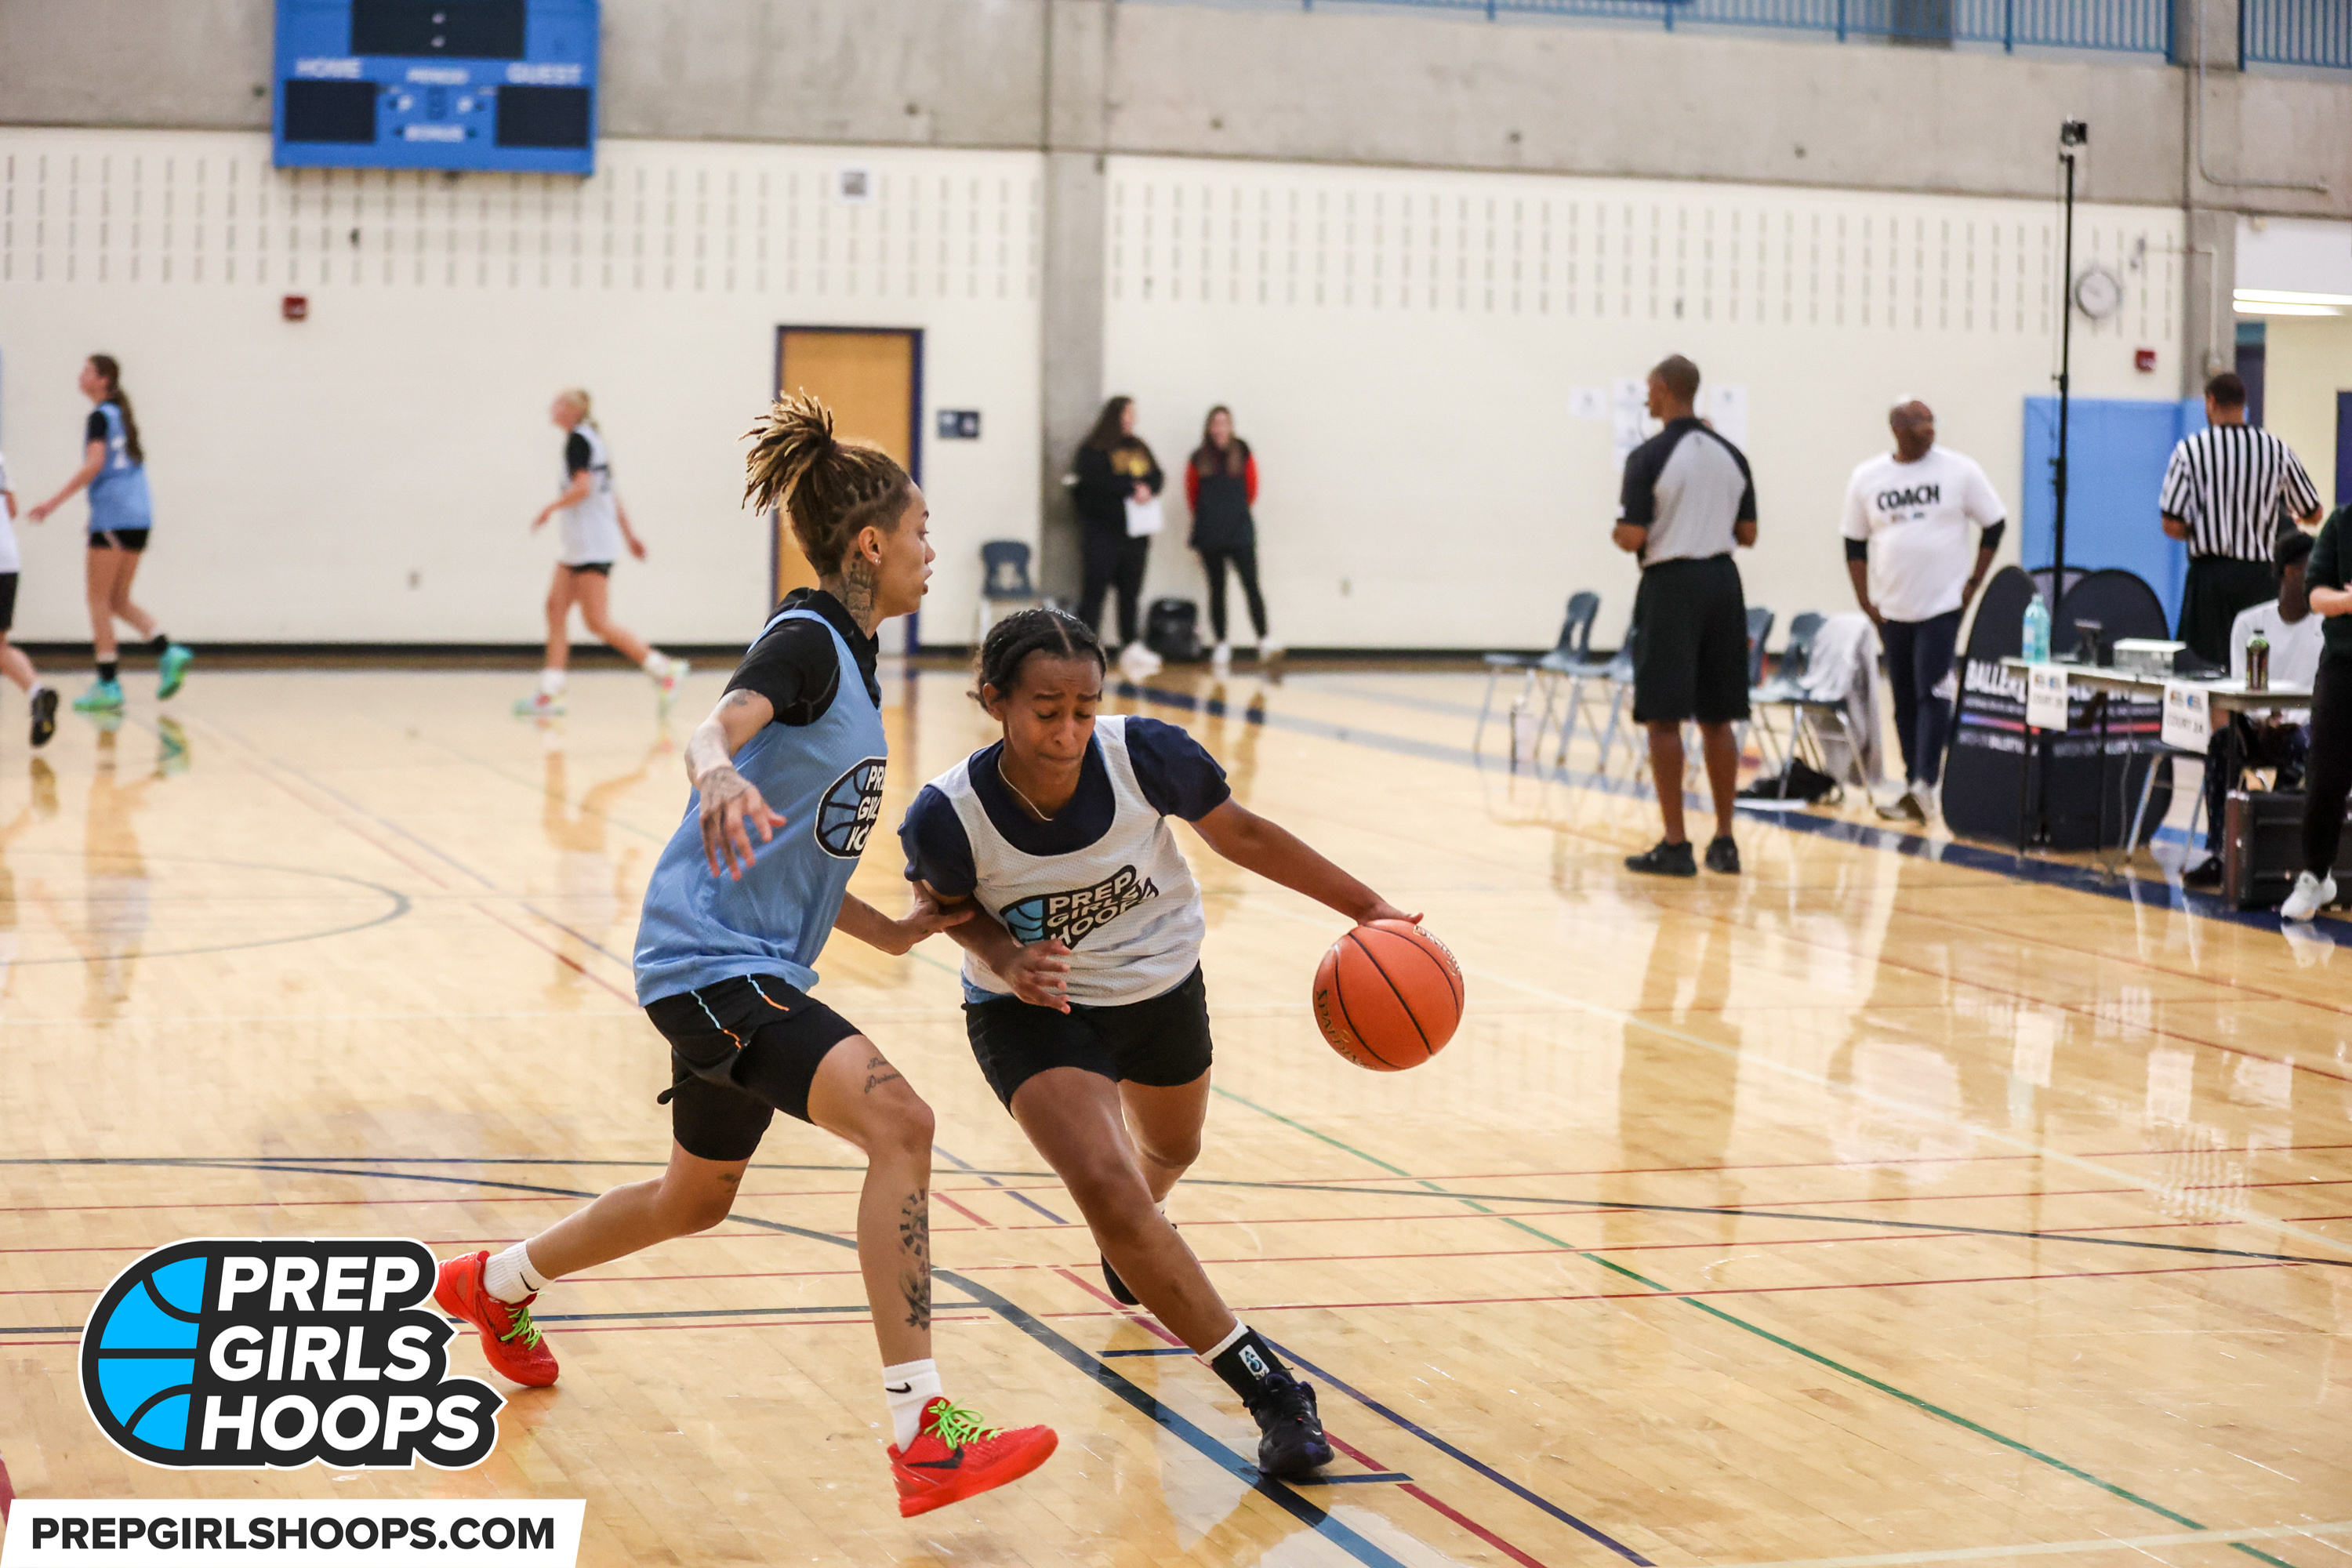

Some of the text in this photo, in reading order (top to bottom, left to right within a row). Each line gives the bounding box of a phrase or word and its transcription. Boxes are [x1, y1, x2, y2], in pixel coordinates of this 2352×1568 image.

[1878, 484, 1940, 511] COACH
[1047, 886, 1139, 927] GIRLS
[1049, 871, 1132, 915] PREP
